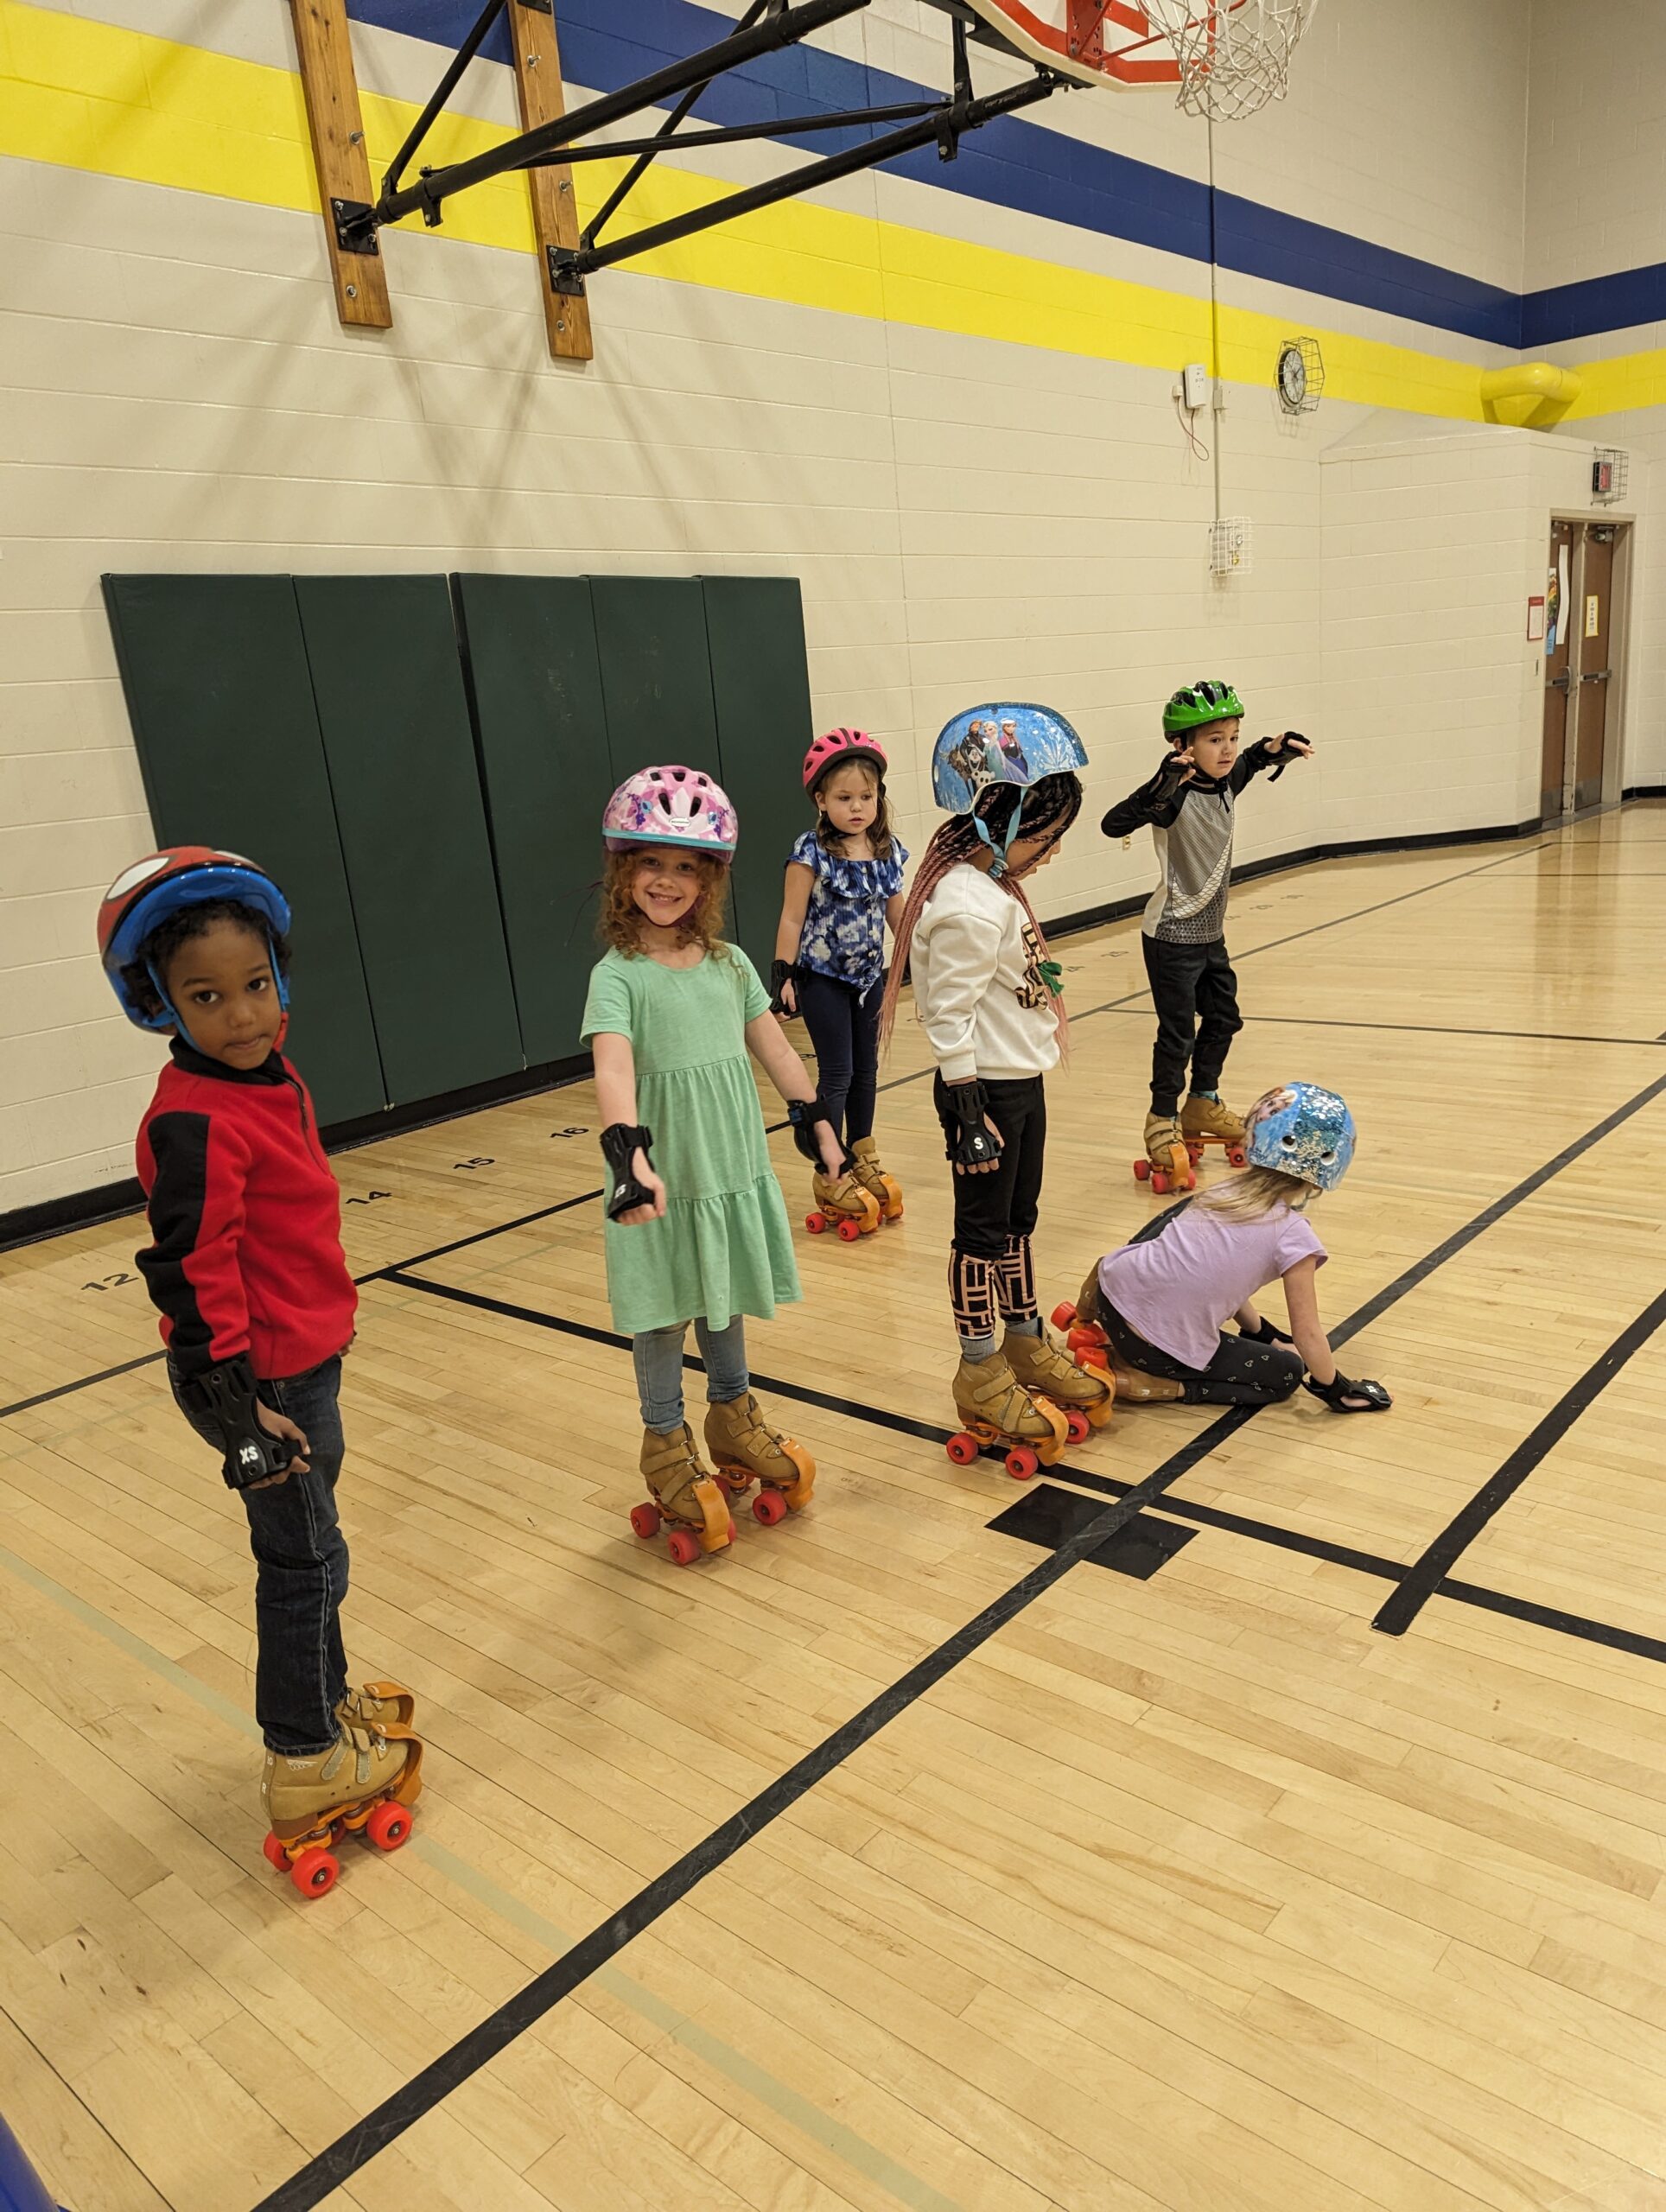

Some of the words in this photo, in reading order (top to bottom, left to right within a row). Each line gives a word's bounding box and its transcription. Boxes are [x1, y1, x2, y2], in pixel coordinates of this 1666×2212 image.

[550, 1127, 589, 1139] 16
[974, 1136, 984, 1150] S
[453, 1157, 496, 1171] 15
[346, 1190, 392, 1205] 14
[80, 1273, 140, 1292] 12
[238, 1446, 258, 1465] XS
